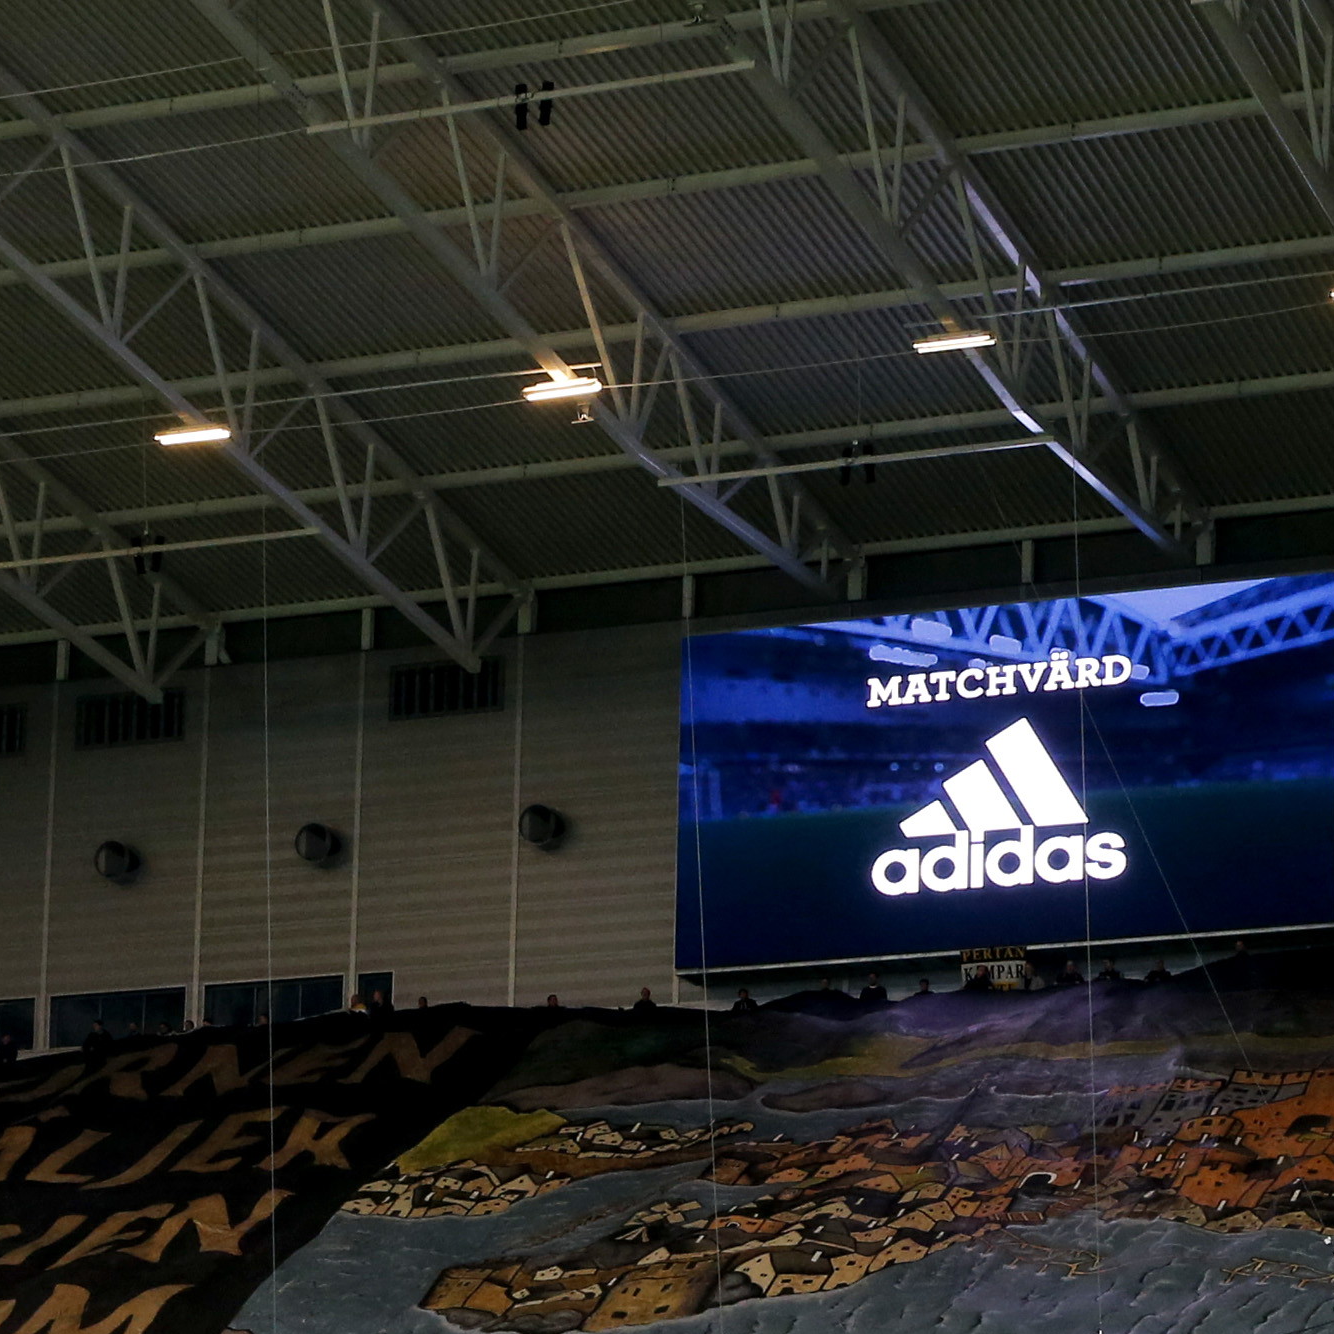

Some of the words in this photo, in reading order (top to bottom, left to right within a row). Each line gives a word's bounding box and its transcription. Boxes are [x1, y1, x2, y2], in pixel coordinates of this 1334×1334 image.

[866, 652, 1133, 707] MATCHVÄRD
[870, 824, 1128, 896] adidas
[964, 963, 1025, 981] KMPAR
